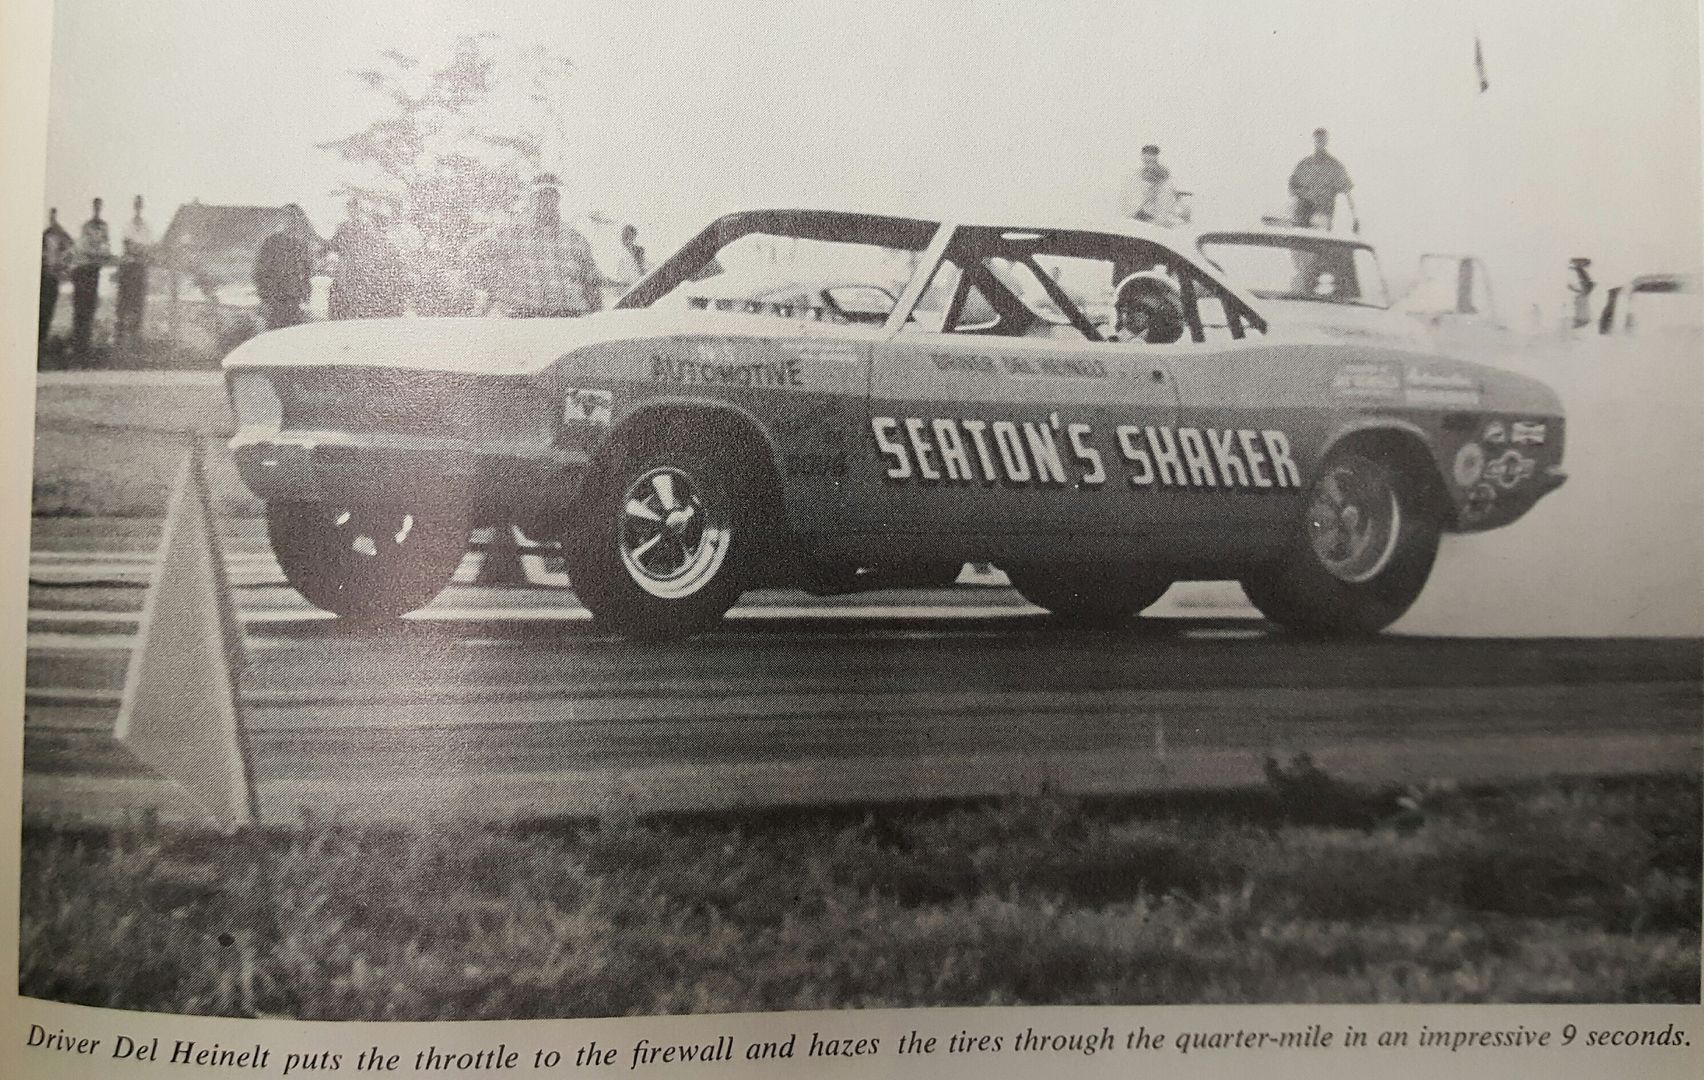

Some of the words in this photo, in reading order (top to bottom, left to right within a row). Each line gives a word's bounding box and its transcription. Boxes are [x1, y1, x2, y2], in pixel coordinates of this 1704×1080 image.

[651, 353, 804, 388] AUTOMOTIVE
[872, 411, 1106, 484] SEATON'S
[1117, 425, 1300, 487] SHAKER
[26, 1024, 100, 1054] Driver
[112, 1035, 158, 1061] Del
[170, 1040, 270, 1069] Heinelt
[283, 1051, 342, 1075] puts
[357, 1046, 400, 1071] the
[415, 1044, 519, 1070] throttle
[534, 1049, 561, 1068] to
[576, 1042, 617, 1066] the
[631, 1036, 733, 1070] firewall
[746, 1034, 796, 1060] and
[809, 1032, 880, 1057] hazes
[899, 1031, 936, 1054] the
[949, 1030, 1003, 1053] tires
[1015, 1027, 1114, 1055] through
[1127, 1027, 1165, 1049] the
[1176, 1025, 1333, 1054] quarter-mile
[1344, 1026, 1366, 1047] in
[1378, 1032, 1407, 1046] an
[1420, 1025, 1551, 1052] impressive
[1562, 1024, 1577, 1046] 9
[1586, 1024, 1690, 1046] seconds.
